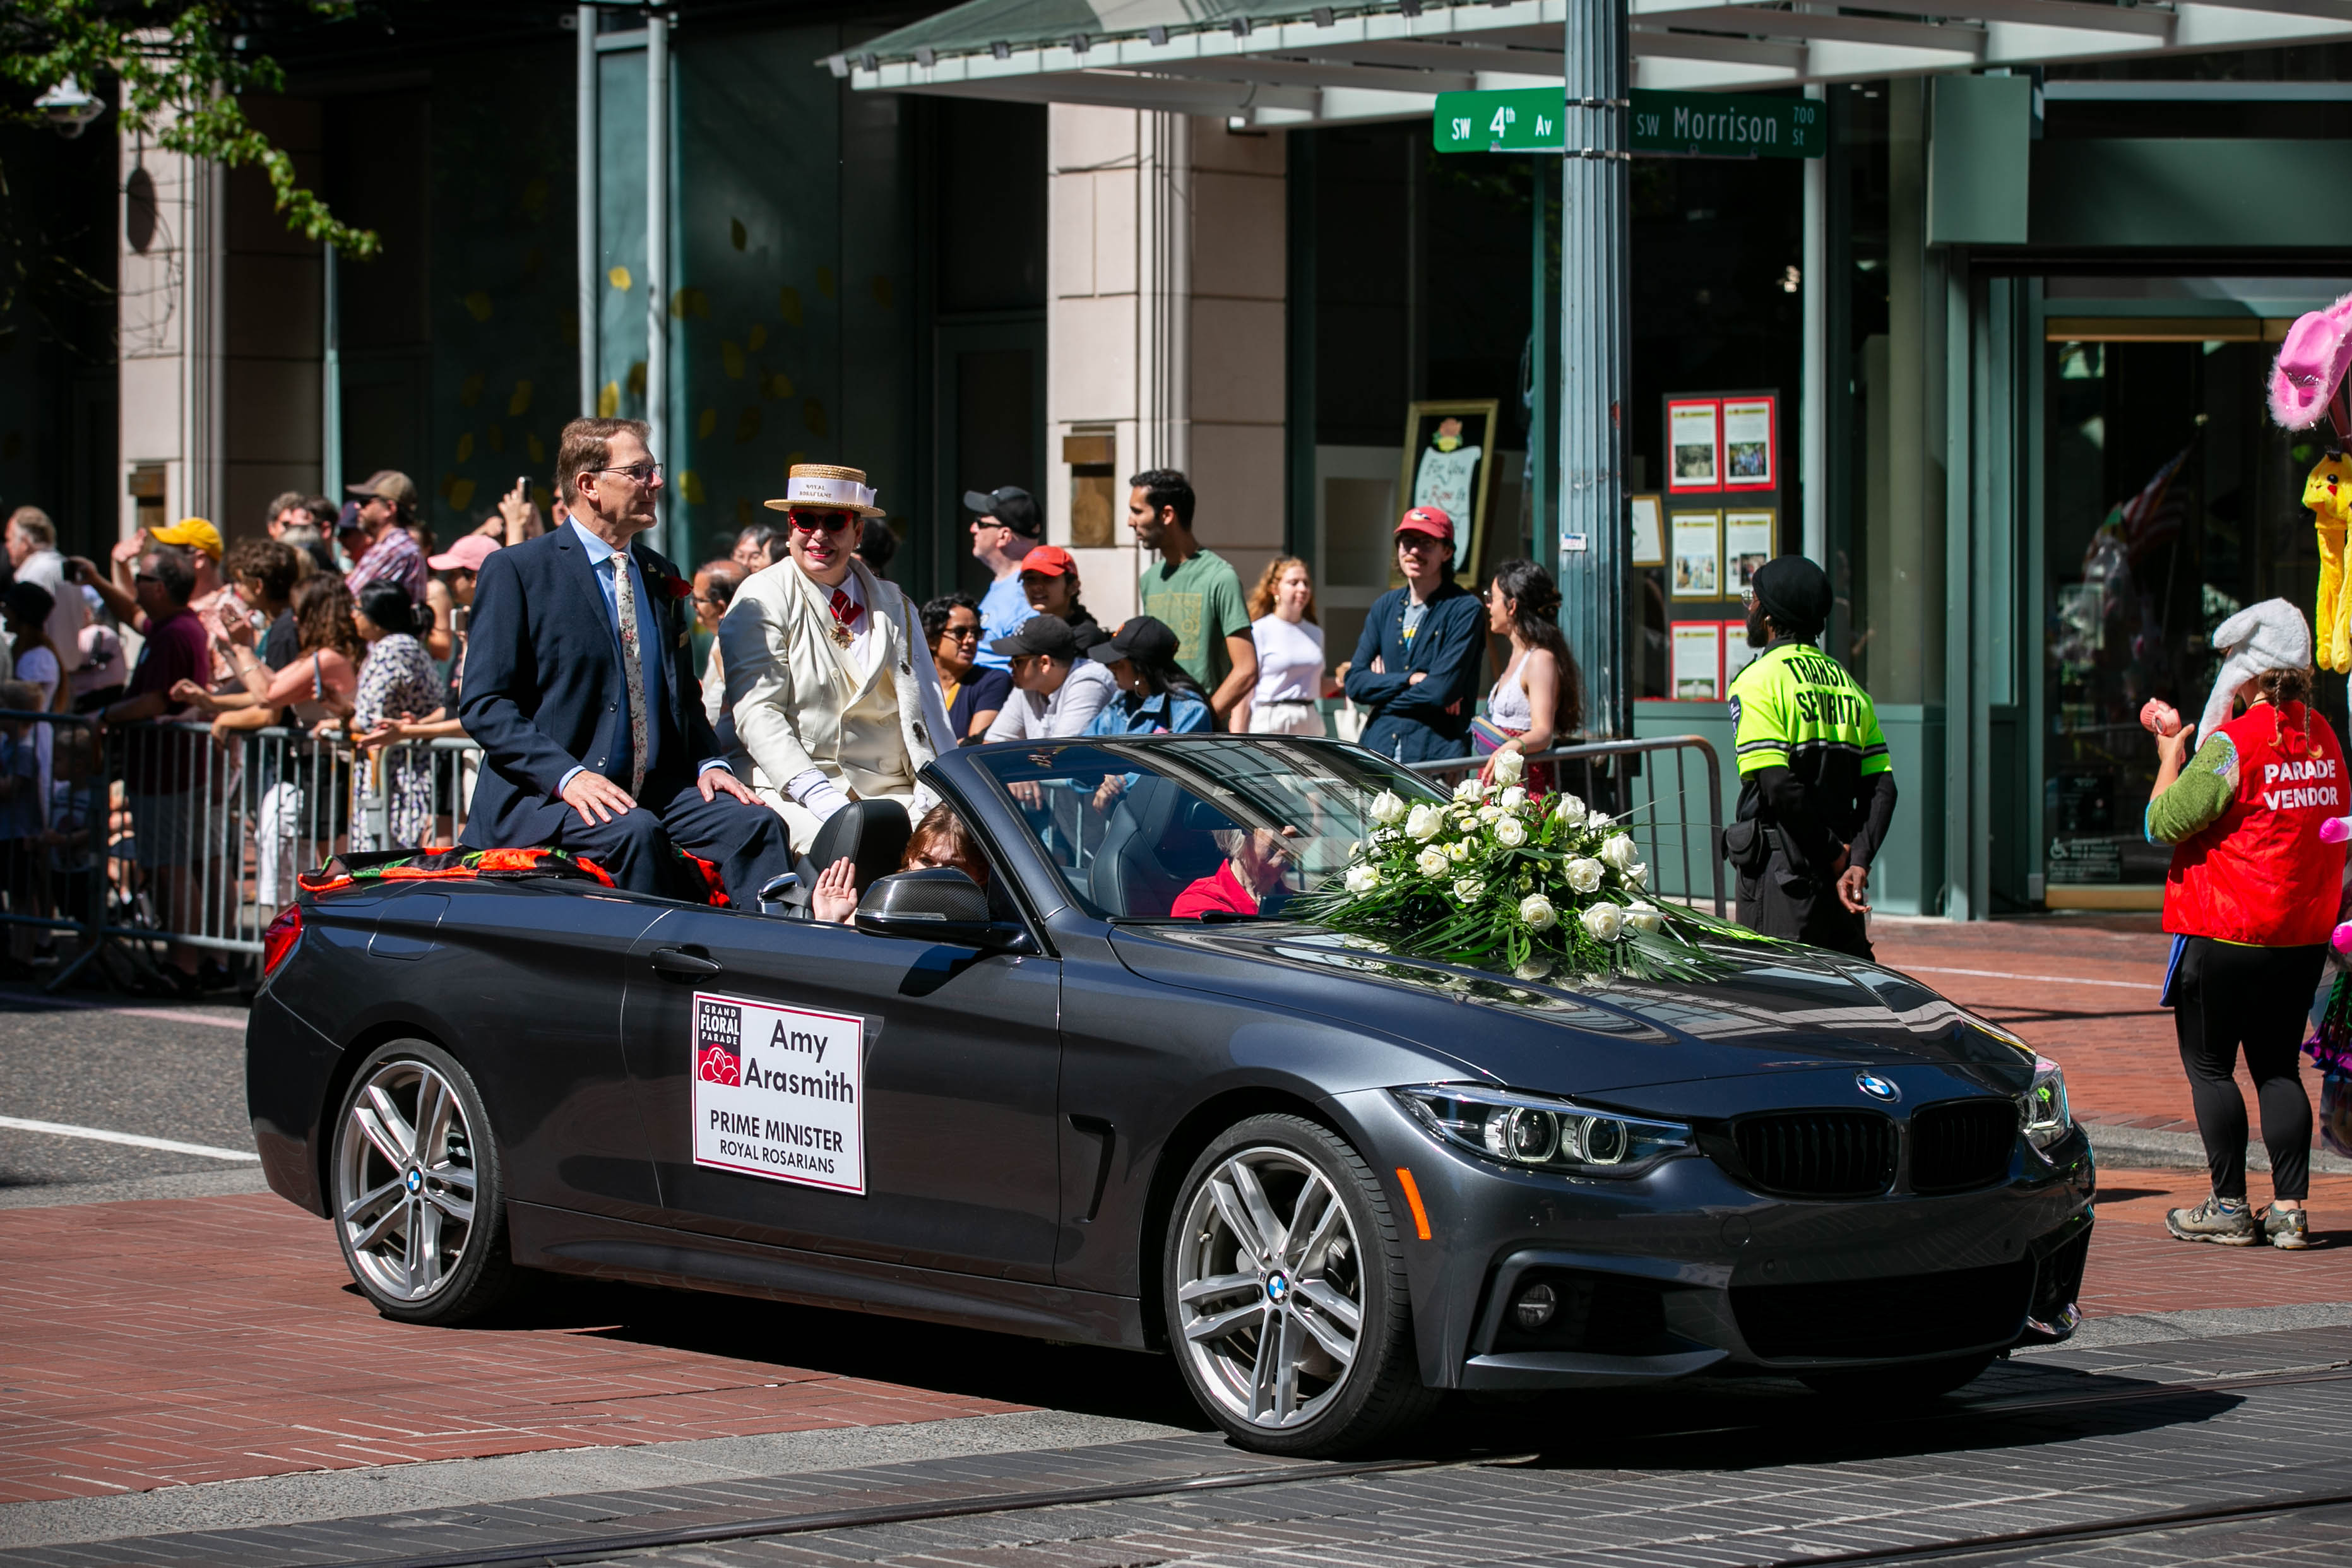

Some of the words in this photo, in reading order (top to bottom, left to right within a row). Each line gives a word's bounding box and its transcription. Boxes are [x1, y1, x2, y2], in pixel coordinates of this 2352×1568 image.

[1452, 117, 1470, 140] SW
[1490, 106, 1515, 138] 4th
[1535, 114, 1552, 136] Av
[1637, 114, 1659, 137] SW
[1674, 107, 1777, 143] Morrison
[1793, 106, 1815, 124] 700
[1793, 128, 1803, 146] St
[1781, 656, 1852, 688] TRANSI
[1796, 689, 1862, 727] SEURITY
[2264, 759, 2336, 784] PARADE
[2264, 787, 2338, 811] VENDOR
[701, 1014, 740, 1036] FLORAL
[704, 1004, 737, 1018] GRAND
[702, 1031, 737, 1045] PARADE
[770, 1019, 828, 1064] Amy
[744, 1058, 853, 1104] Arasmith
[711, 1109, 760, 1138] PRIME
[765, 1119, 844, 1153] MINISTER
[720, 1139, 759, 1161] ROYAL
[763, 1147, 834, 1174] ROSARIANS
